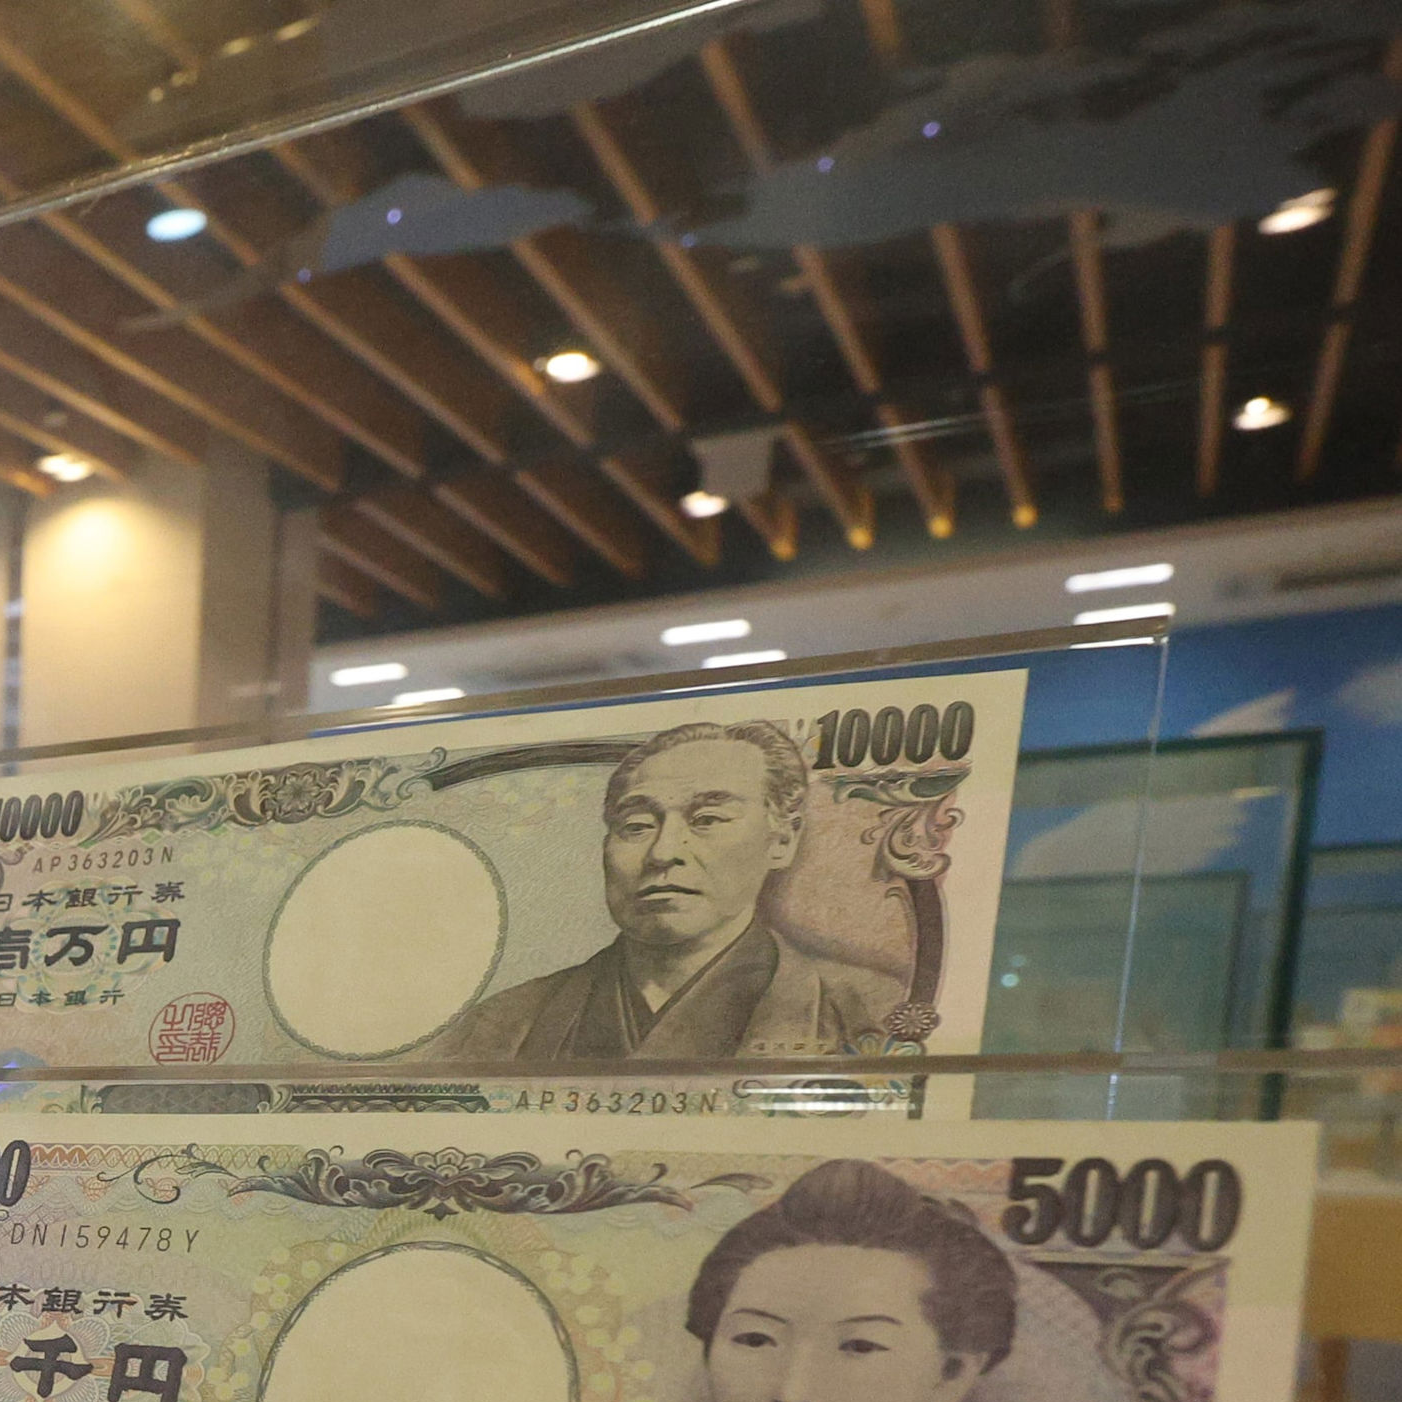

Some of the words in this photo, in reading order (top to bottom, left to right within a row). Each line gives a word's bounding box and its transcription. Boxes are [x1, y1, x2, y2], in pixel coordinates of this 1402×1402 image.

[814, 700, 974, 769] 10000
[32, 847, 175, 875] AP363203N
[1004, 1157, 1243, 1252] 5000
[10, 1222, 199, 1255] DN159478Y
